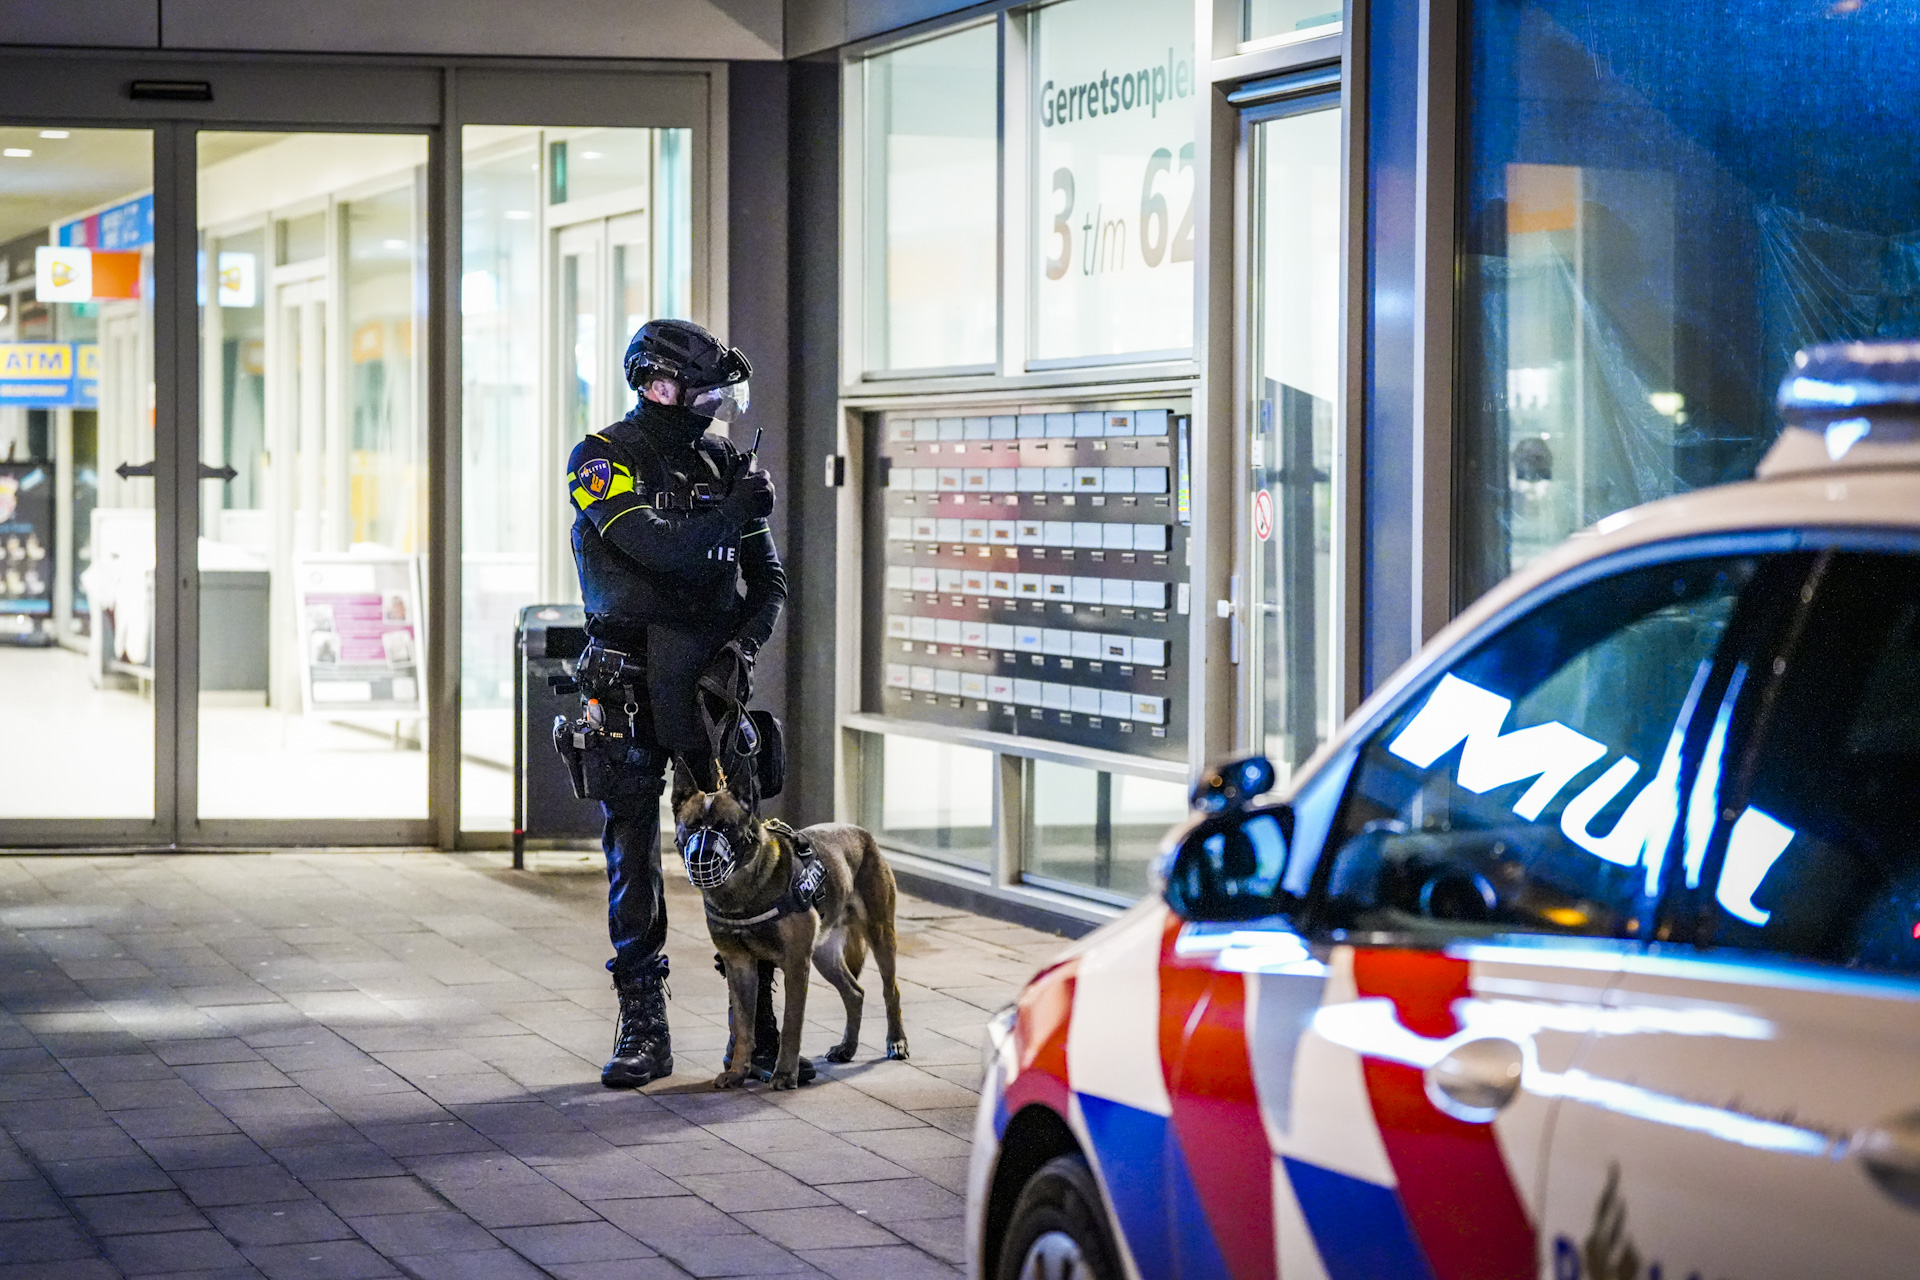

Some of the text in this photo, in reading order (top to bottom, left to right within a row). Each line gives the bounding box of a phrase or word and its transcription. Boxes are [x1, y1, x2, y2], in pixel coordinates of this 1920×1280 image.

[1045, 141, 1195, 281] 3 t/m 62
[6, 352, 63, 370] ATM
[580, 462, 607, 478] POLITIE
